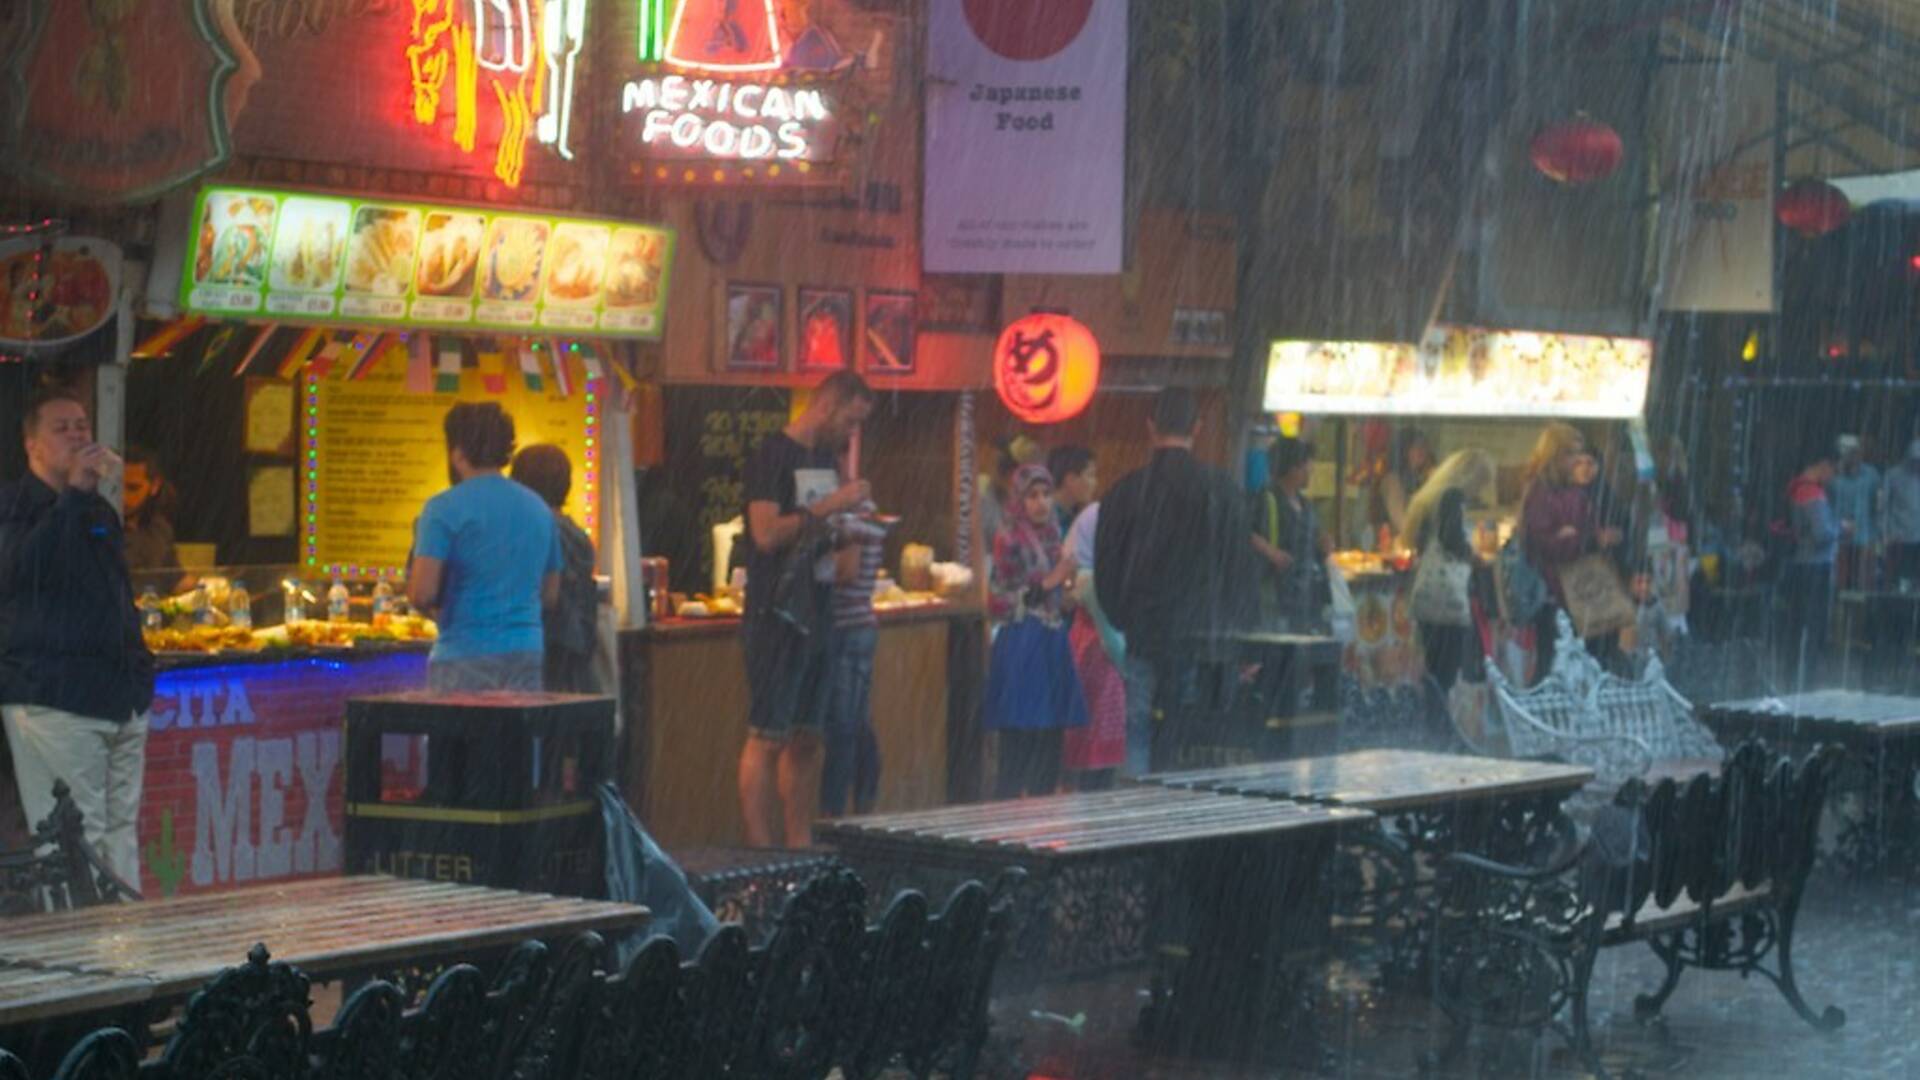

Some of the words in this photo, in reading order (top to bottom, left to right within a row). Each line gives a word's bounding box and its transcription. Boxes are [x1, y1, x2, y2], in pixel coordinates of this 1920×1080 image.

[622, 75, 826, 121] MEXICAN
[969, 83, 1082, 105] Japanese
[642, 110, 807, 159] FOODS
[994, 112, 1054, 131] Food
[373, 852, 473, 881] LITTER
